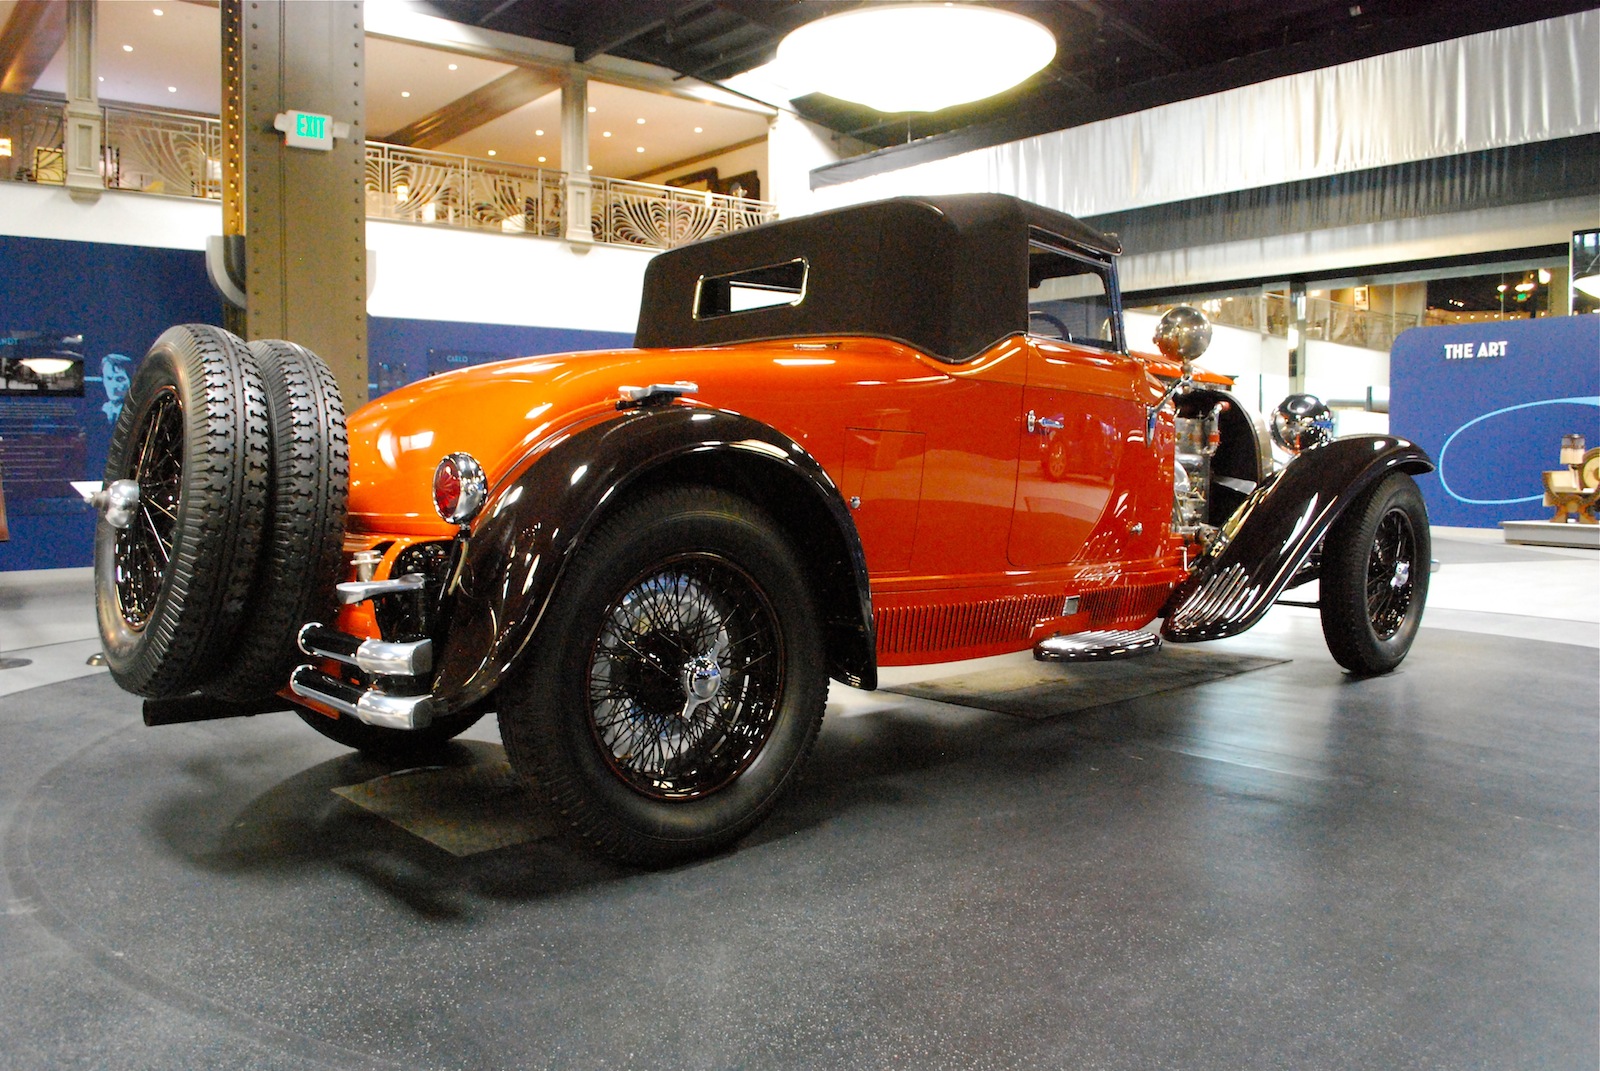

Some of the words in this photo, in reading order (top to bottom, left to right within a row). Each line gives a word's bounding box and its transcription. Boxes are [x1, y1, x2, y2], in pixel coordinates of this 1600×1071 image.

[297, 114, 326, 139] EXIT
[1444, 343, 1473, 359] THE
[1477, 341, 1508, 357] ART
